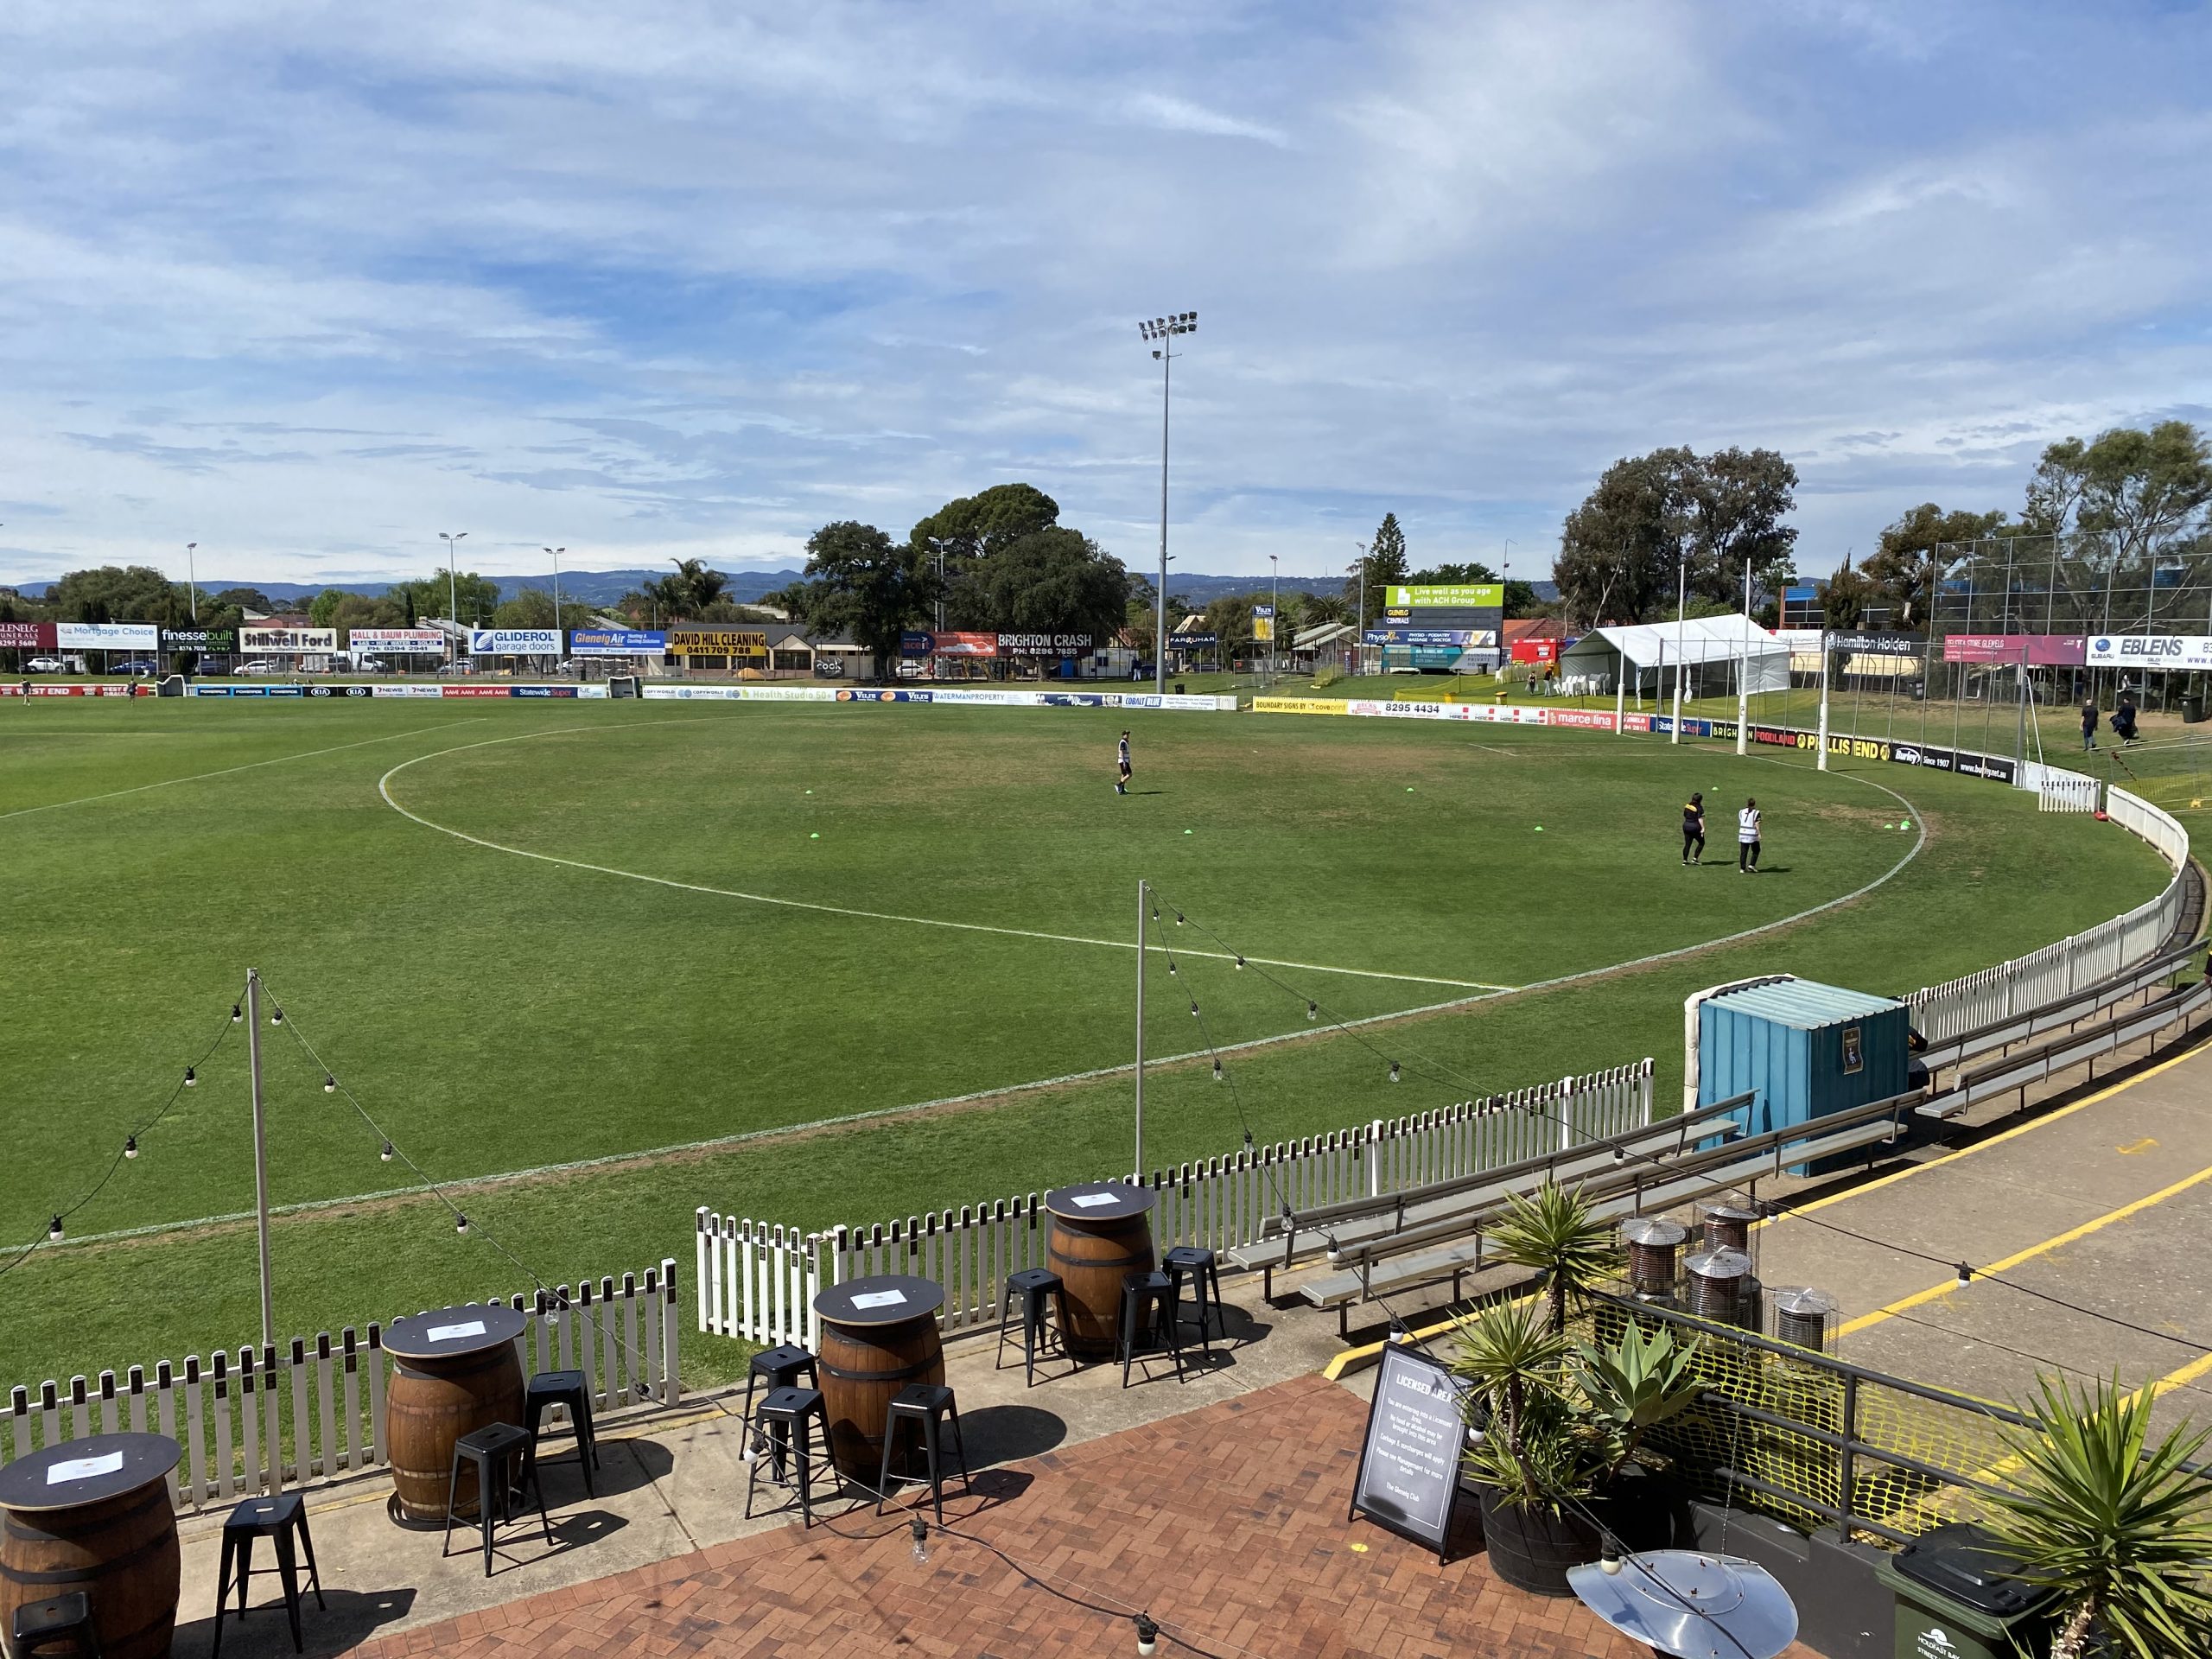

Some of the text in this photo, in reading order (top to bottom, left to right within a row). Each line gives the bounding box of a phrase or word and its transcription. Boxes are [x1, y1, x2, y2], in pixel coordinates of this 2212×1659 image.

[74, 627, 154, 636] Mortgage Choice
[494, 632, 555, 641] GLIDEROL
[245, 633, 332, 646] Stillwell Ford
[674, 633, 699, 645] DAVID
[702, 633, 720, 645] HILL
[721, 633, 765, 646] CLEANING
[998, 634, 1091, 646] BRIGHTON CRASH
[1367, 633, 1389, 644] Physio
[1836, 635, 1876, 649] Hamilton
[1877, 637, 1910, 652] Holden
[496, 642, 555, 652] garage doors
[2120, 639, 2183, 657] EBLENS
[1125, 696, 1145, 706] COBALT
[1385, 703, 1440, 713] 8295 4434
[1687, 723, 1703, 734] Supr
[1713, 727, 1753, 740] BRIGHN
[1808, 735, 1878, 759] PLLIS END
[1895, 750, 1917, 764] Burley
[1923, 756, 1950, 768] Since 1907
[1960, 764, 2006, 779] www.buley.net.au
[1396, 1373, 1452, 1403] LICENSED AREA
[1402, 1404, 1419, 1417] entering
[1433, 1414, 1452, 1427] Licensed
[1392, 1423, 1408, 1434] brought
[1417, 1433, 1426, 1442] this
[1426, 1438, 1436, 1446] area
[1410, 1422, 1427, 1433] alcohol
[1427, 1430, 1435, 1439] may
[1380, 1433, 1395, 1446] Corkage
[1432, 1455, 1445, 1465] apply
[1376, 1446, 1389, 1457] Please
[1397, 1455, 1424, 1474] Management
[1430, 1470, 1443, 1480] more
[1399, 1465, 1414, 1476] details
[1394, 1485, 1409, 1499] Glenelg
[1409, 1491, 1420, 1502] Club
[1917, 1636, 1947, 1656] HOLDFAST
